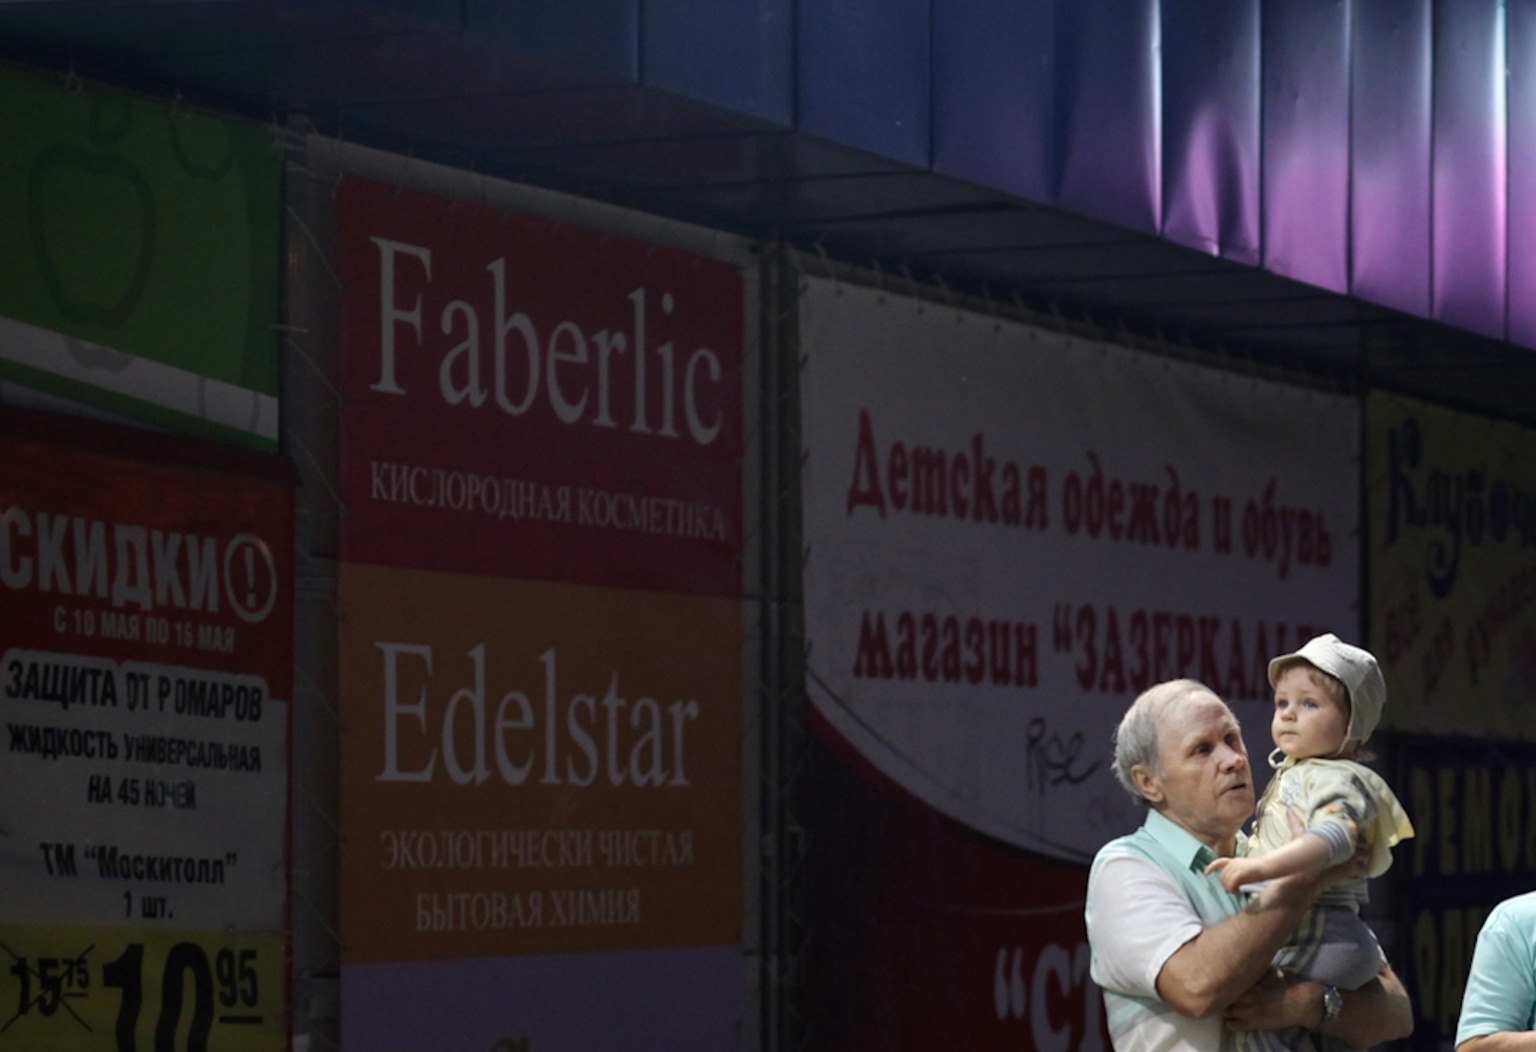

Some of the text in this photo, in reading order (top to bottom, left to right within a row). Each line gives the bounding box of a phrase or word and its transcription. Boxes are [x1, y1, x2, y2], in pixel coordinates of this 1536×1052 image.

[369, 235, 723, 445] Faberlic
[370, 461, 727, 541] КИСЛОРОДНАЯ КОСМЕТИКА
[847, 408, 1332, 580] Детская одежда и обувь
[53, 605, 235, 653] С 10 МАЯ ПО 16 МАЯ
[853, 608, 1037, 688] магазин
[1053, 603, 1333, 700] “ЗАЗЕРКАЛ
[6, 660, 117, 709] ЗАЩИТА
[126, 672, 151, 711] ОТ
[374, 641, 698, 788] Edelstar
[7, 723, 261, 772] ЖИДКОСТЬ УНИВЕРСАЛЬНАЯ
[88, 775, 196, 809] НА 45 НОЧЕЙ
[40, 843, 77, 878] ТМ
[380, 829, 694, 870] ЭКОЛОГИЧЕСКИ ЧИСТАЯ
[142, 895, 173, 919] шт.
[416, 888, 640, 931] БЫТОВАЯ ХИМИЯ
[217, 948, 258, 1008] 95
